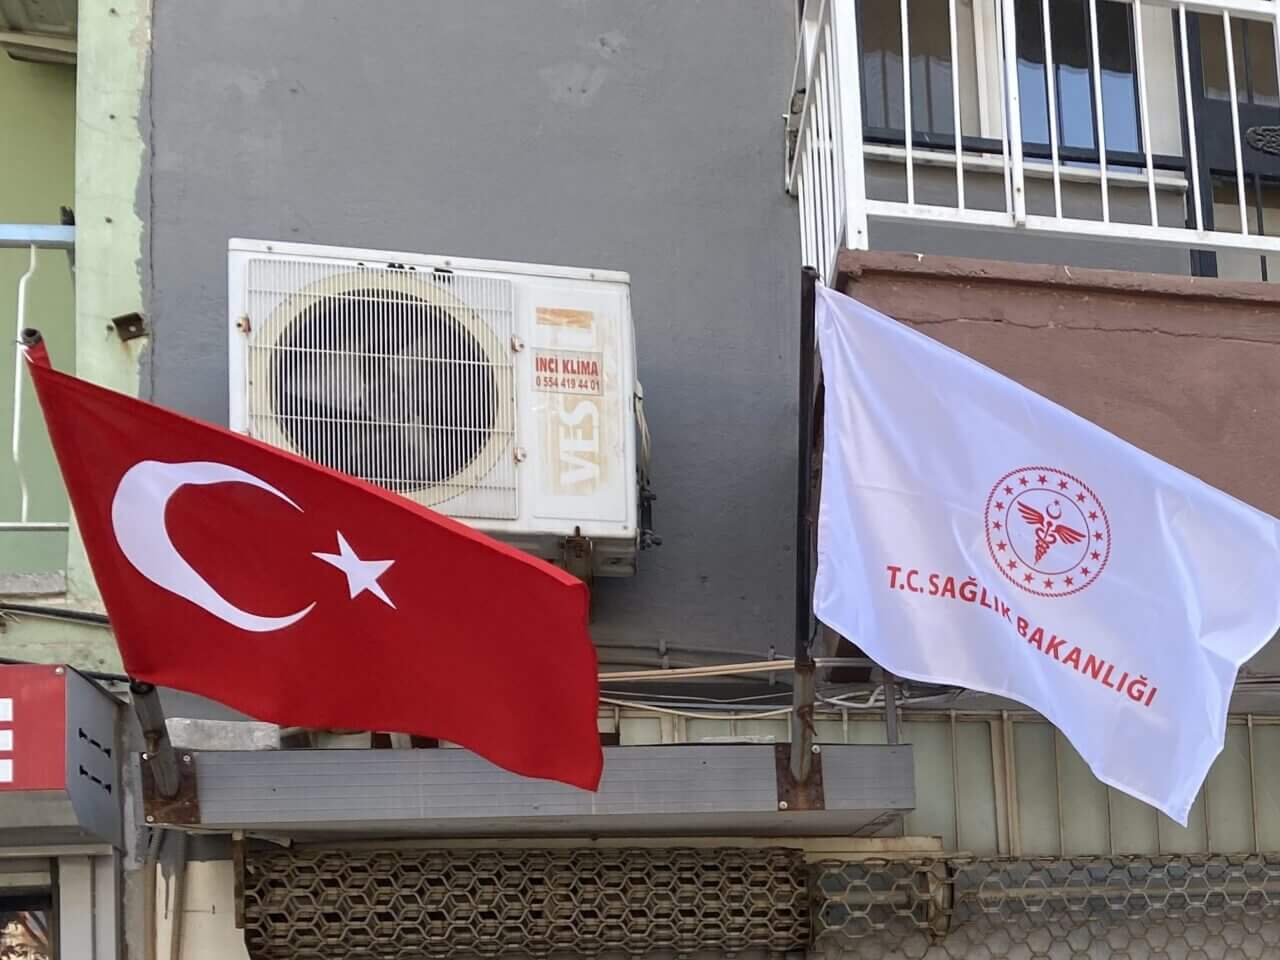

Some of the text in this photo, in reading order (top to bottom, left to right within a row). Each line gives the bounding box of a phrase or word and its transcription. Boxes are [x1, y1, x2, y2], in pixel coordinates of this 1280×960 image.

[535, 376, 600, 391] 0 554 419 44 01
[886, 565, 1158, 707] T.C. SAĞLIK BAKANLIĞI
